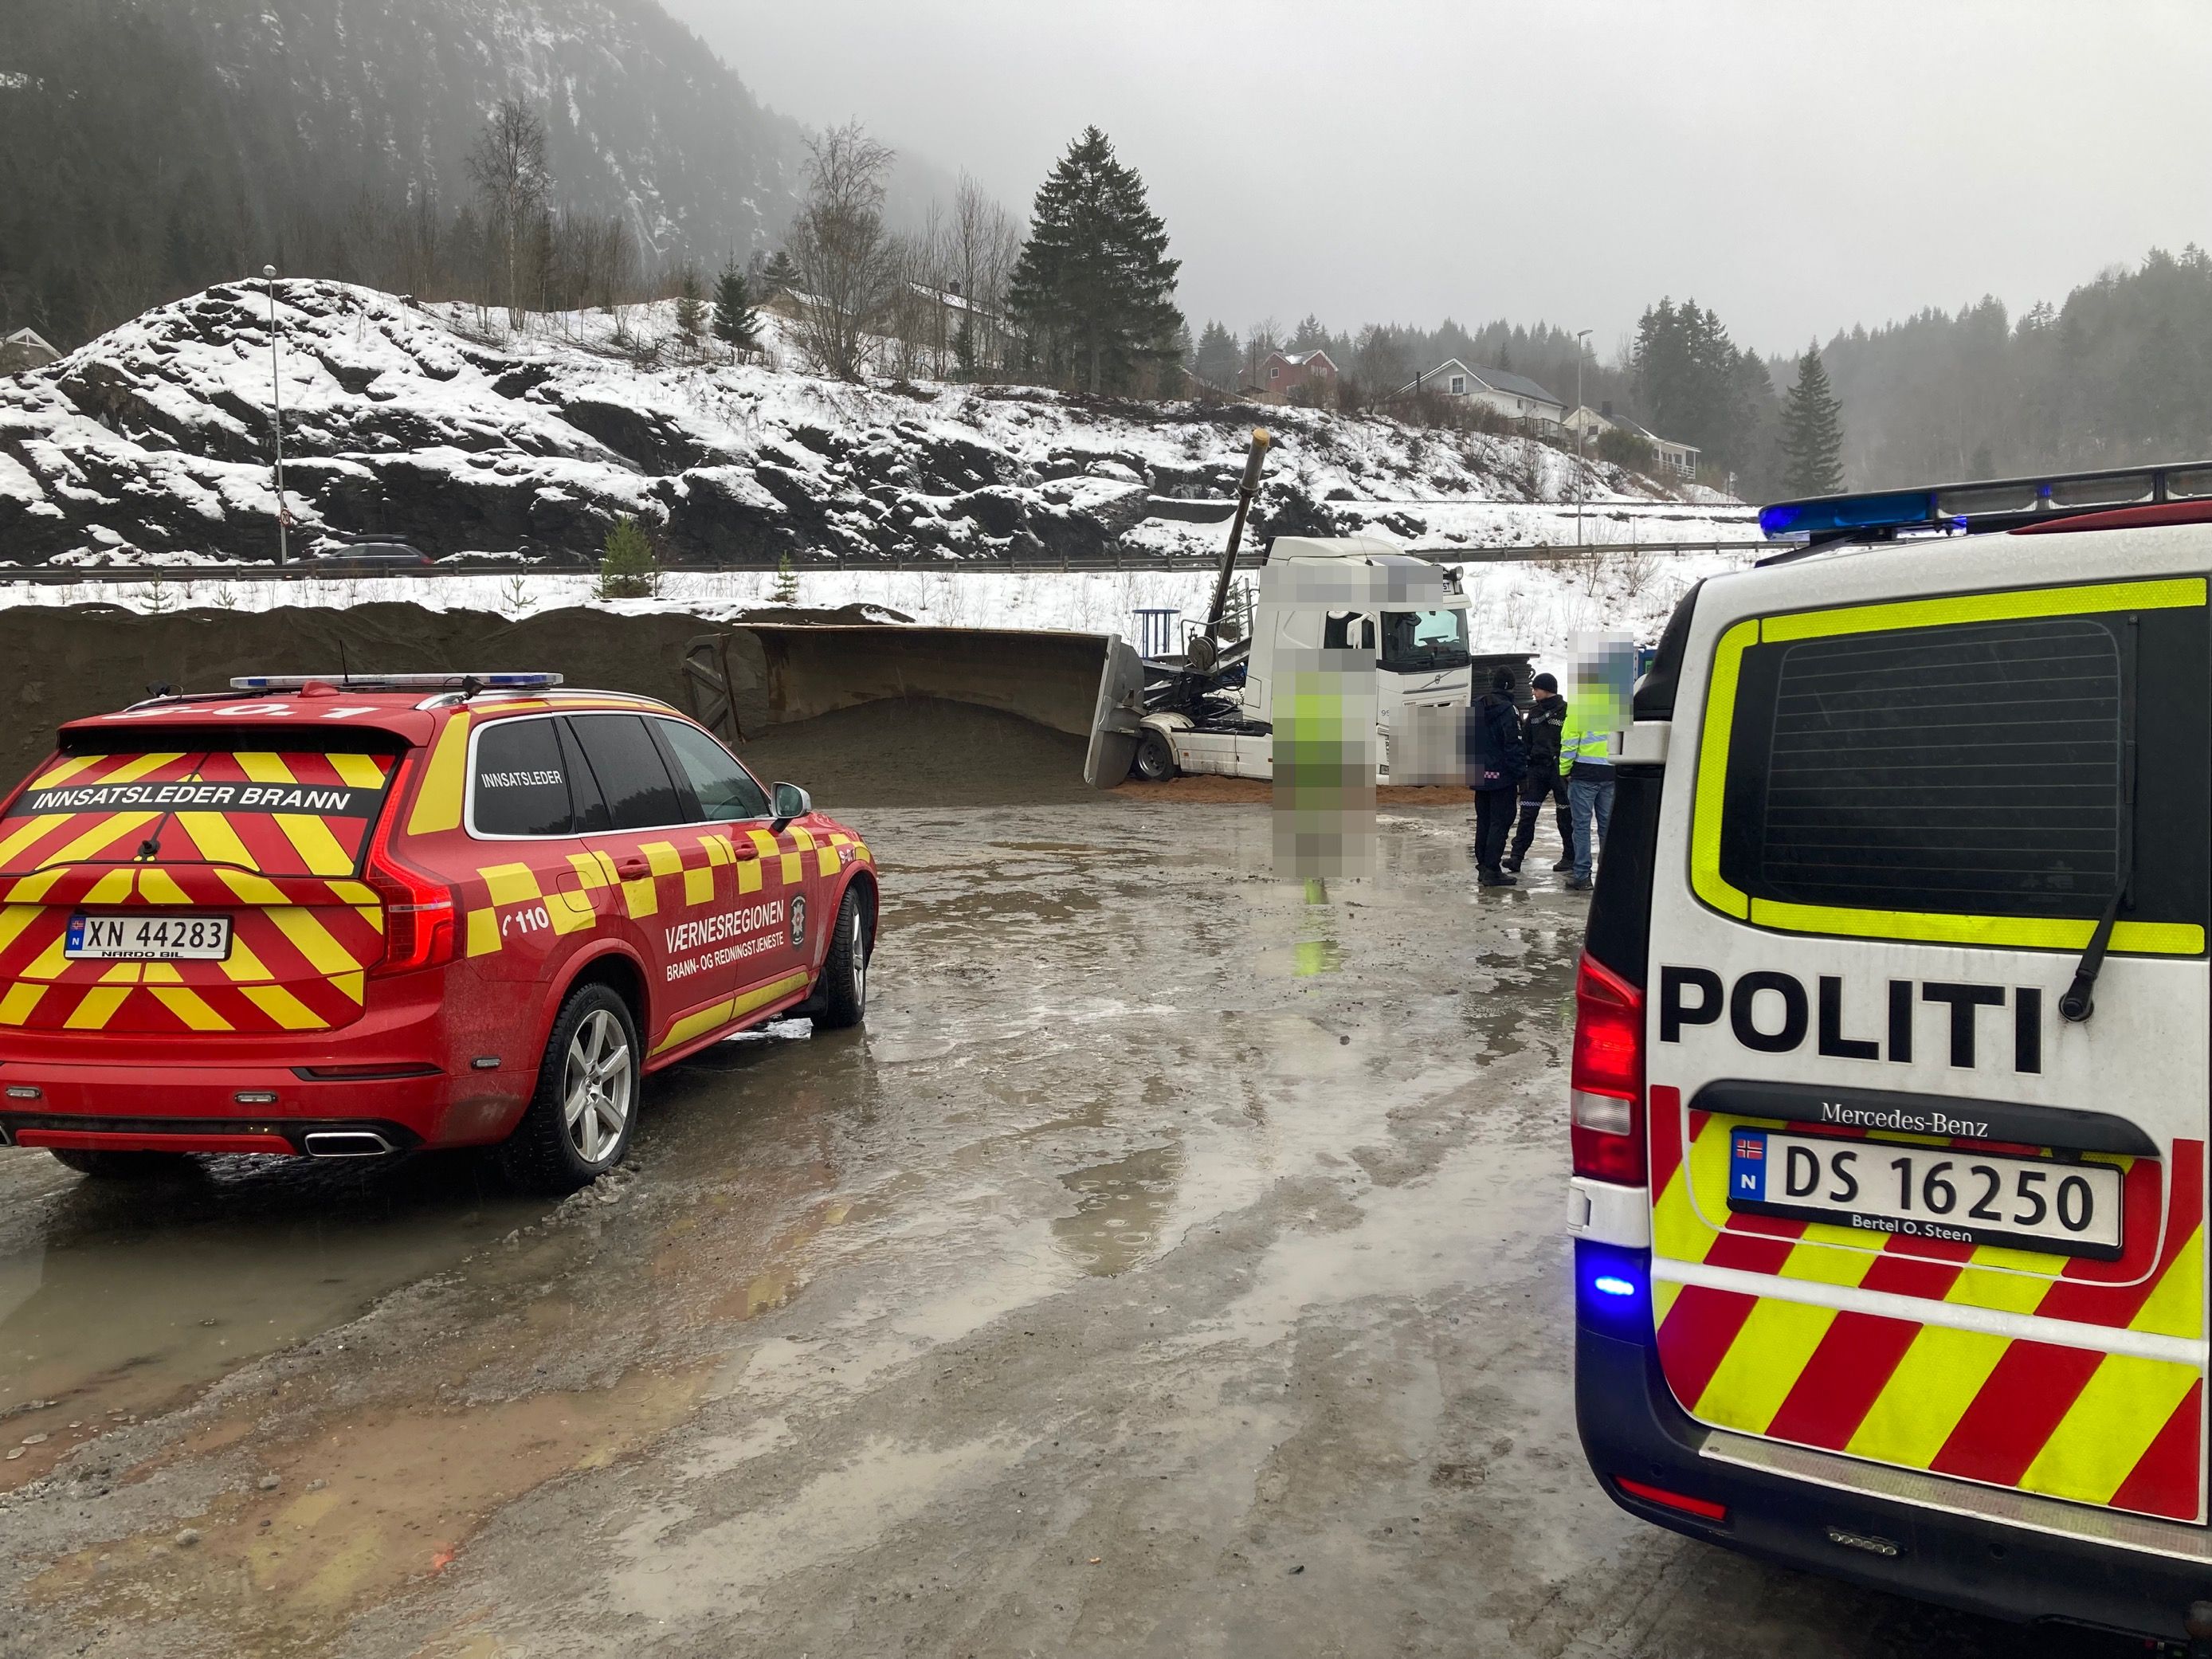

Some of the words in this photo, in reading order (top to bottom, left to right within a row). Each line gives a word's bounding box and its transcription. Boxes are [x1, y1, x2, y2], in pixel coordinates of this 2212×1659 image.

[480, 770, 563, 788] INNSATSLEDER
[32, 786, 235, 810] INNSATSLEDER
[239, 786, 351, 810] BRANN
[515, 906, 549, 933] 110
[665, 899, 784, 955] VÆRNESREGIONEN
[72, 937, 80, 946] N
[87, 920, 124, 947] XN
[135, 921, 222, 948] 44283
[666, 958, 700, 982] BRANN-
[700, 955, 714, 971] OG
[714, 931, 784, 967] REDNINGSTJENESTE
[1660, 965, 2042, 1075] POLITI
[1820, 1102, 1989, 1138] Mercedes-Benz
[1740, 1175, 1756, 1190] N
[1786, 1145, 1859, 1203] DS
[1890, 1157, 2094, 1232] 16250
[1852, 1214, 1899, 1233] Bertel
[1903, 1221, 1922, 1236] O.
[1924, 1224, 1972, 1243] Steen
